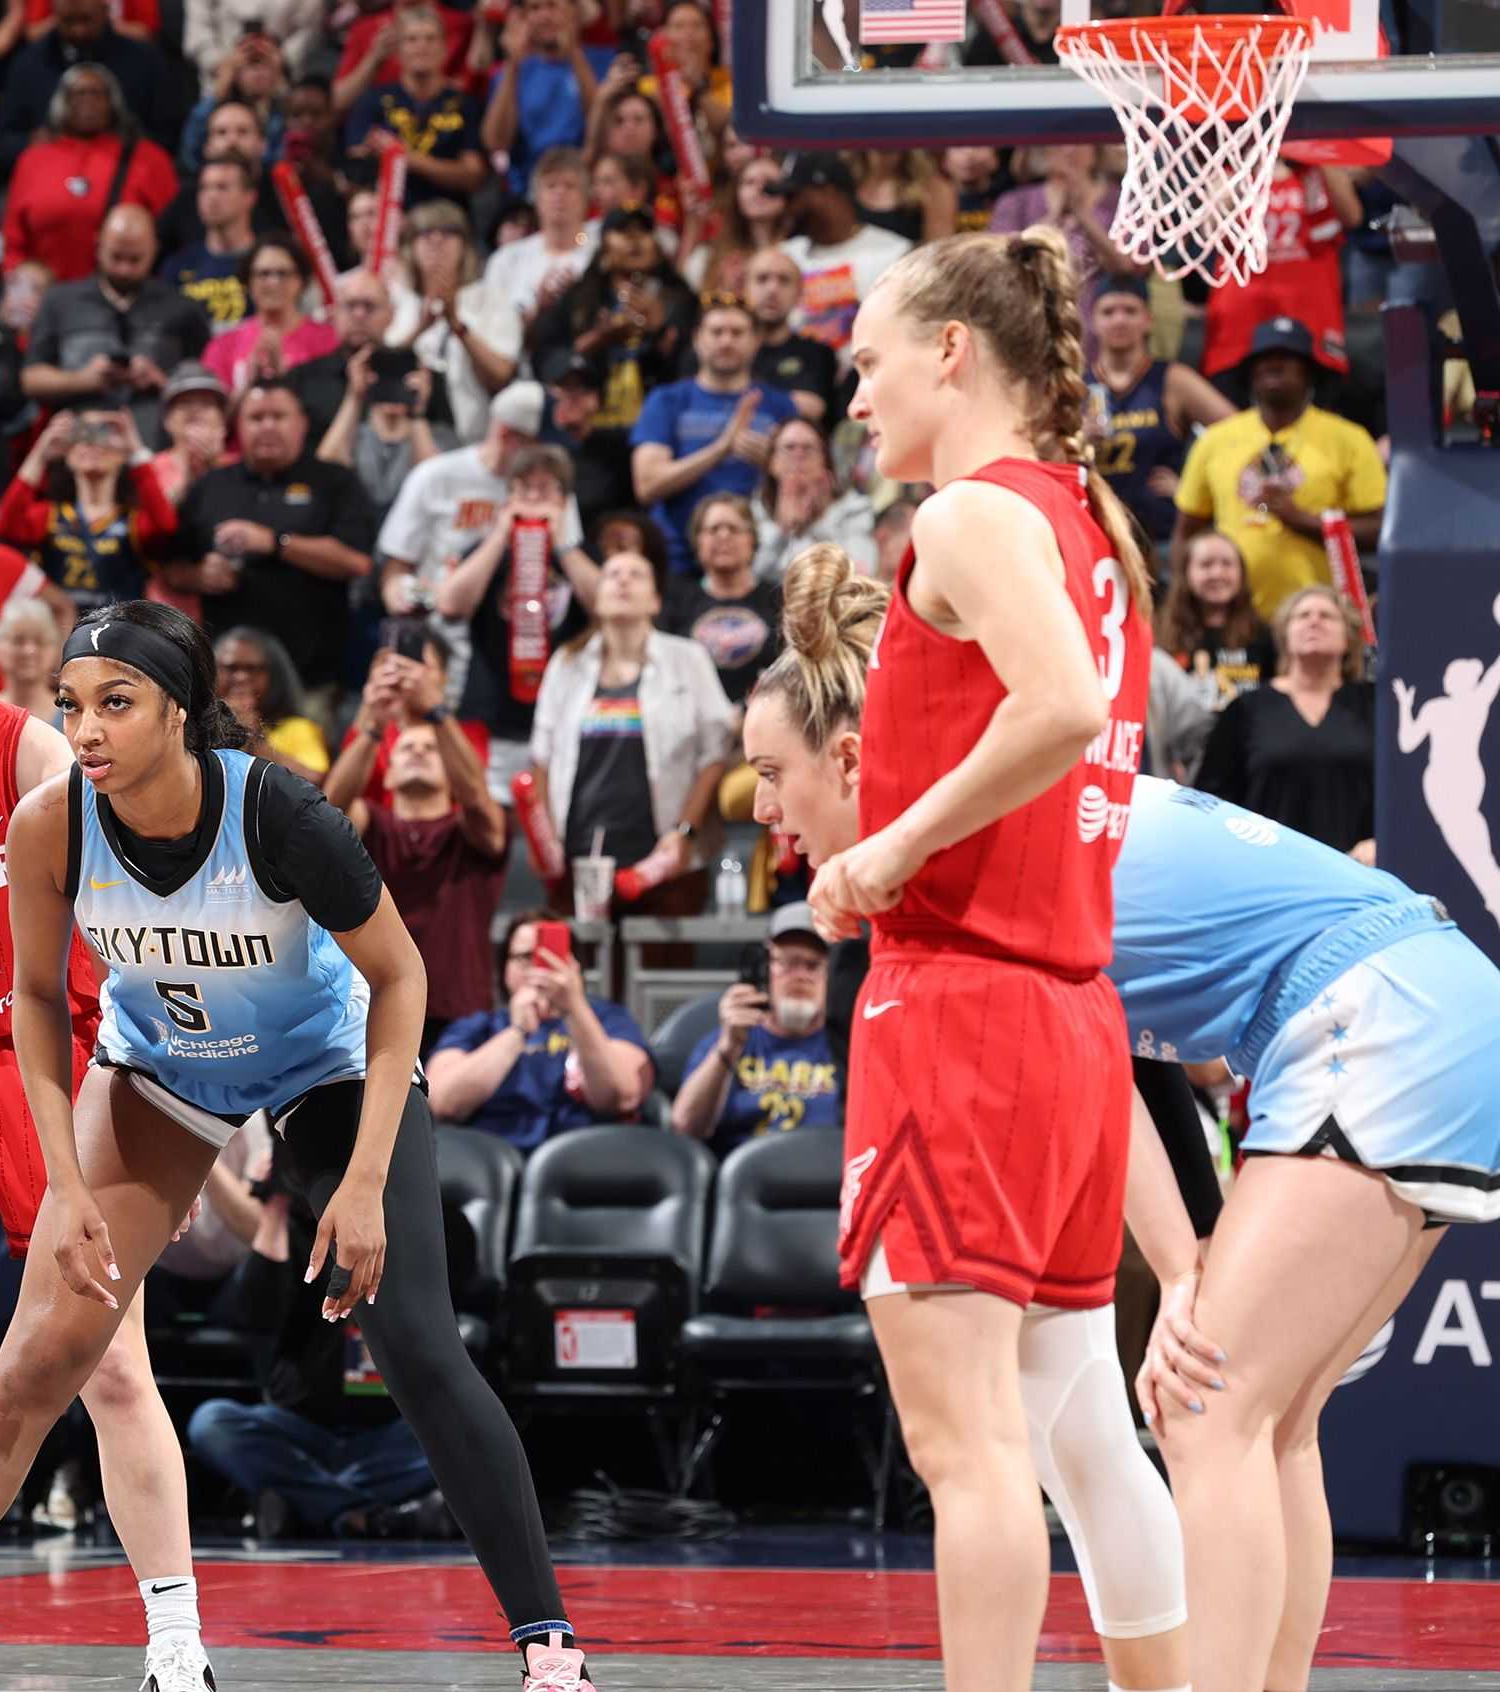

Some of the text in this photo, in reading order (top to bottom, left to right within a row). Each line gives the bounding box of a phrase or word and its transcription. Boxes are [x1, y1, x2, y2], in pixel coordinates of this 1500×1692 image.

[1091, 556, 1129, 702] 3
[154, 979, 212, 1034] 5
[167, 1043, 260, 1059] Medicine
[171, 1029, 256, 1050] UChicago
[737, 1055, 837, 1094] CLARK
